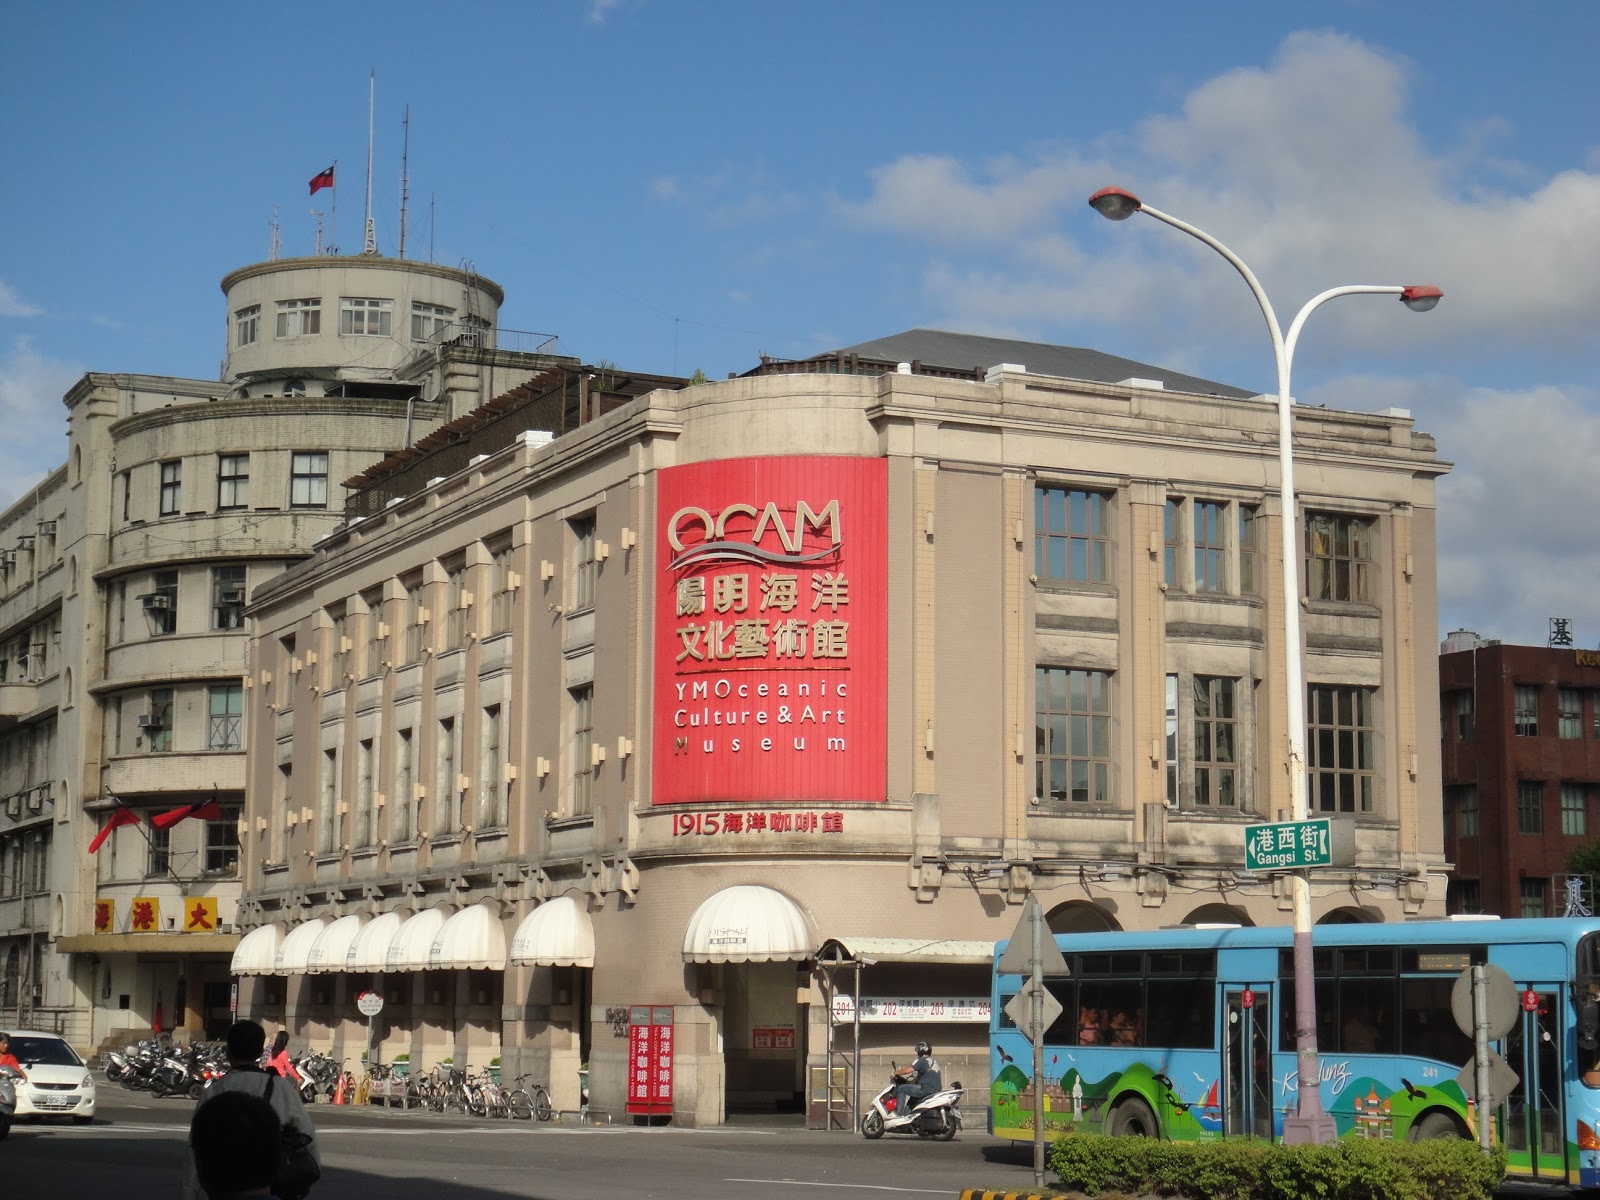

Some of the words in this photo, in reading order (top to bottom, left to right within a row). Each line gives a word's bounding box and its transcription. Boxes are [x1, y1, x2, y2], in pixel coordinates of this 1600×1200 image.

[675, 572, 848, 616] 陽明海洋
[675, 619, 848, 661] 文化藝術館
[1551, 619, 1572, 645] 基
[674, 735, 846, 755] Museum
[1256, 826, 1319, 852] 港西街
[1257, 851, 1296, 866] Gangsi
[1304, 850, 1319, 862] St.
[836, 1002, 850, 1016] 201
[883, 1002, 897, 1016] 202
[930, 1002, 944, 1016] 203
[1423, 1067, 1438, 1077] 241
